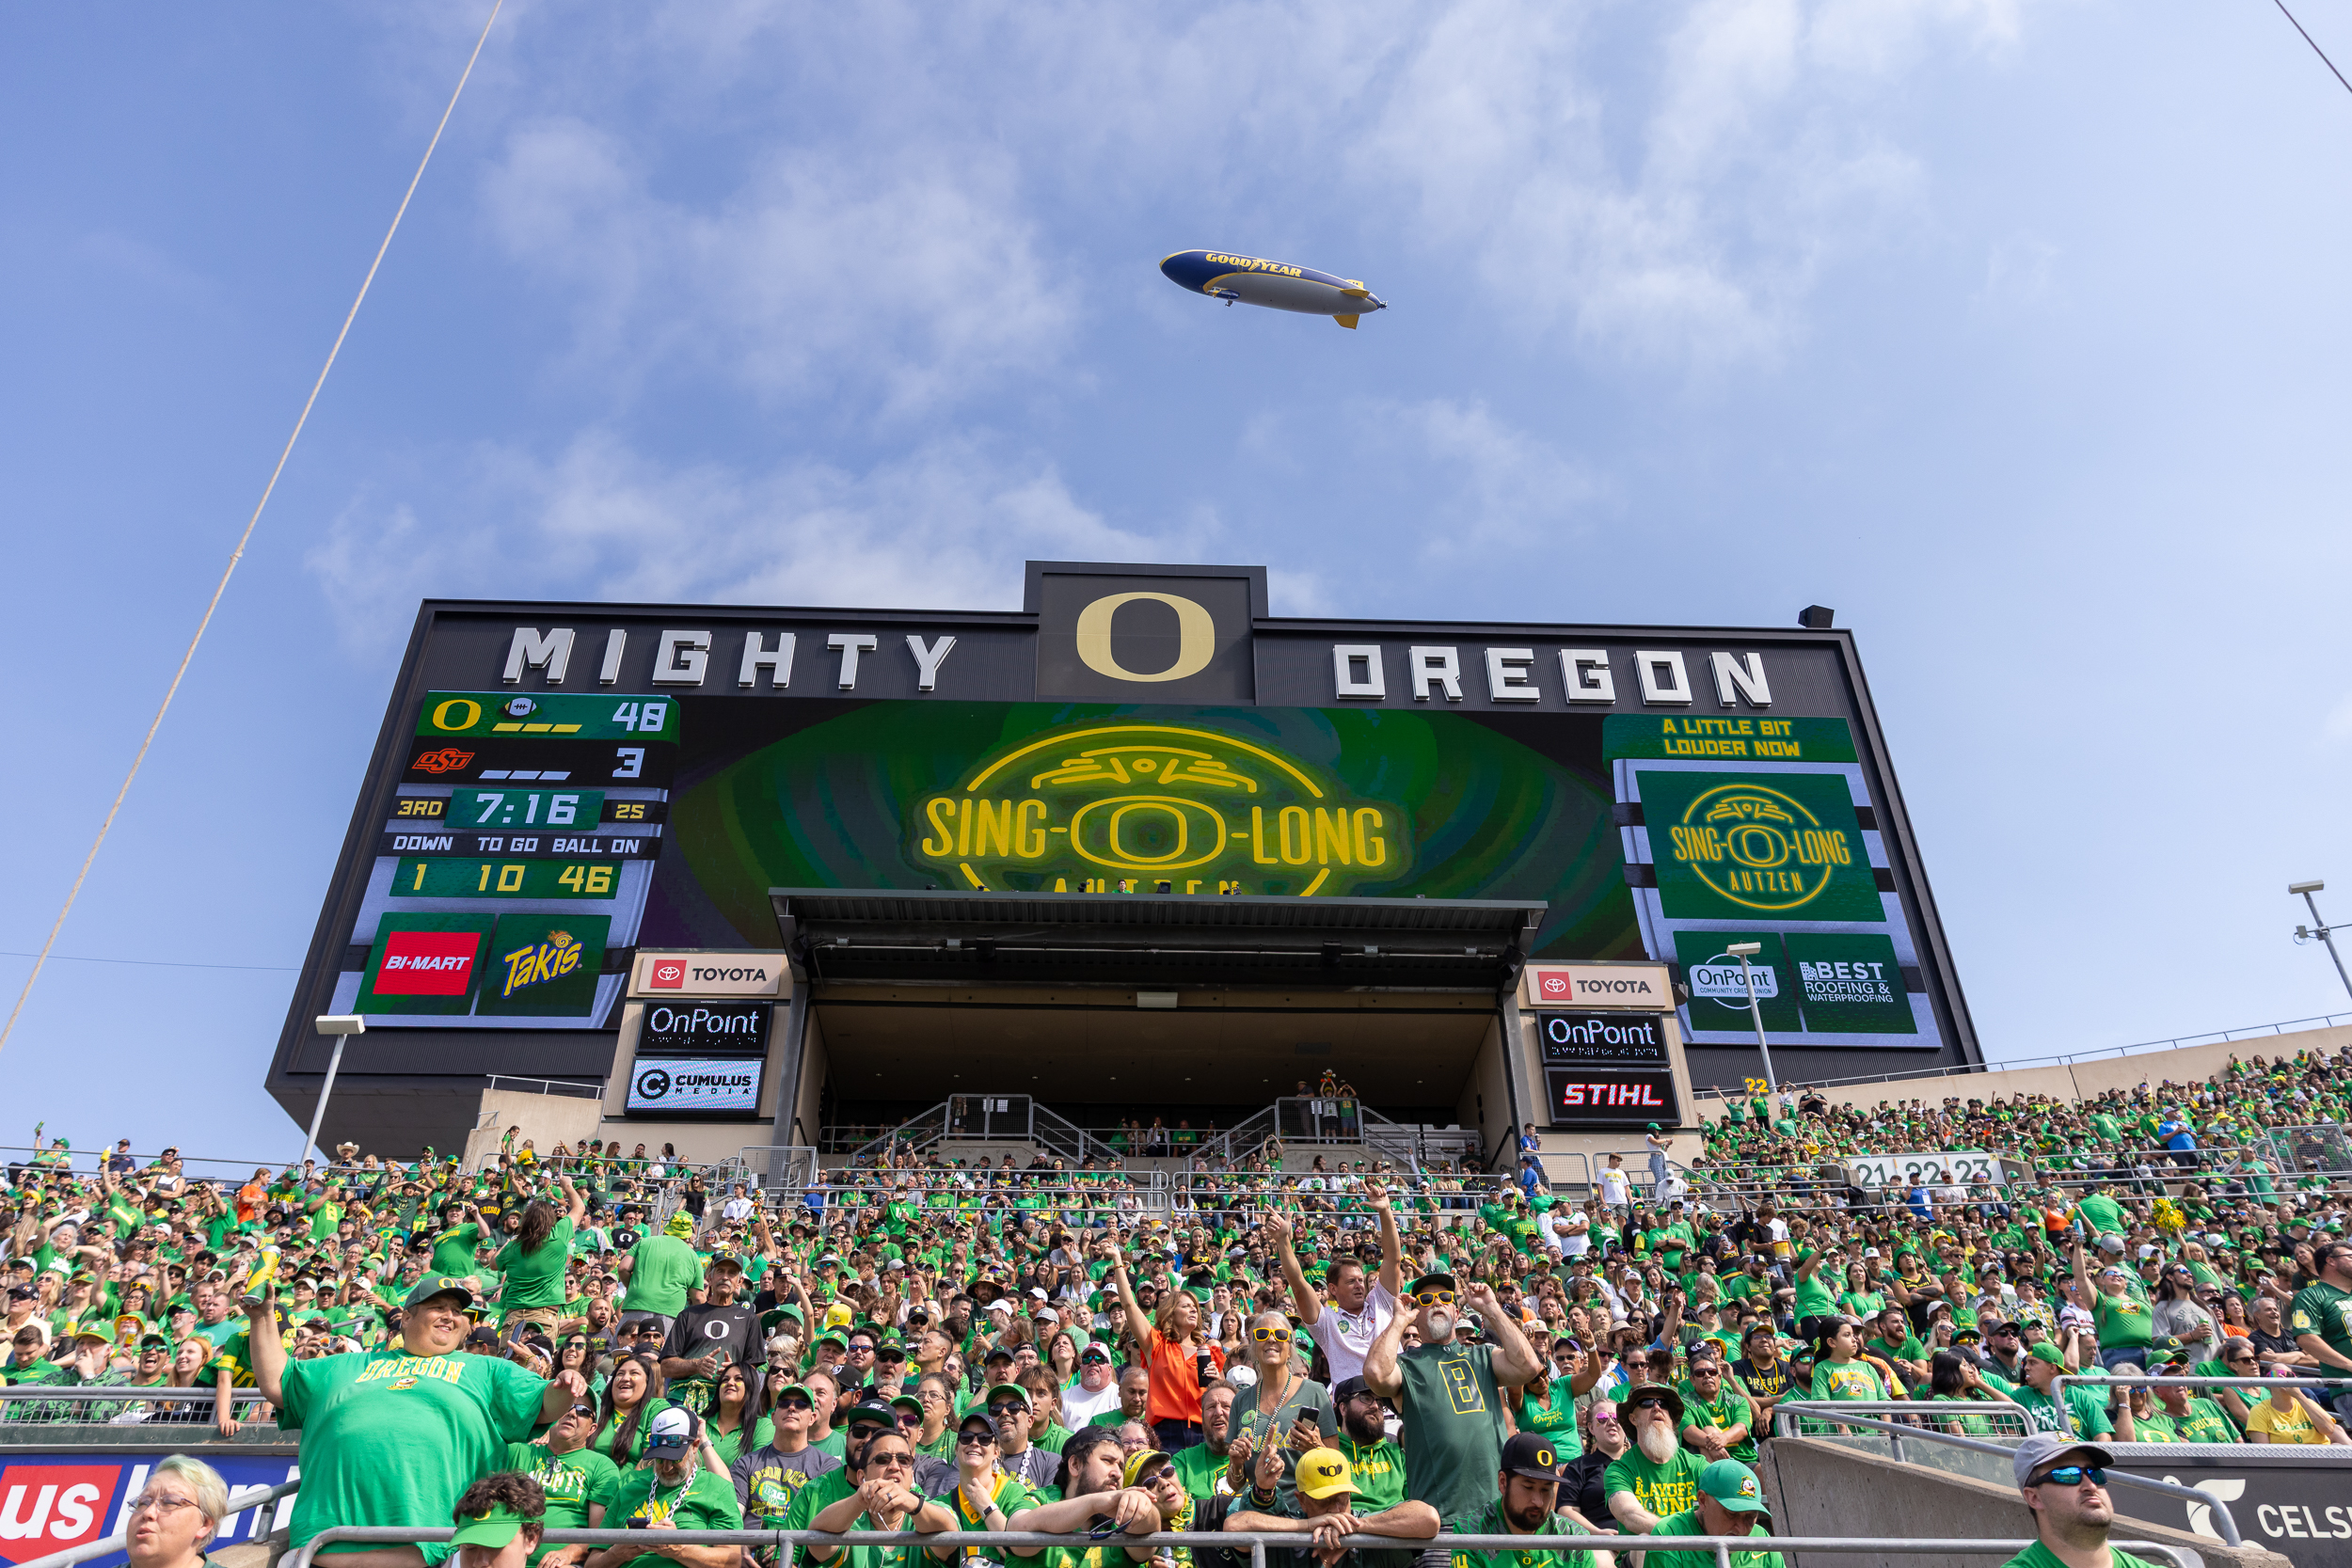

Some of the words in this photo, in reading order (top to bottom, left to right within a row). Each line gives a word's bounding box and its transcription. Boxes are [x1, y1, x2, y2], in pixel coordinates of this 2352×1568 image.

[1205, 253, 1302, 277] GOODYEAR
[1076, 591, 1216, 682] O
[502, 627, 957, 691] MIGHTY
[1333, 644, 1772, 708] OREGON
[612, 702, 667, 732] 48
[1663, 719, 1677, 734] A
[1683, 719, 1754, 736] LITTLE
[1759, 721, 1791, 736] BIT
[1663, 739, 1747, 755] LOUDER
[1754, 741, 1801, 756] NOW
[612, 748, 645, 778] 3
[397, 800, 443, 816] 3RD
[476, 793, 580, 825] 7:16
[392, 835, 453, 851] DOWN
[478, 837, 503, 852] TO
[509, 838, 539, 853] GO
[551, 838, 602, 853] BALL
[611, 839, 640, 853] ON
[412, 863, 428, 891] 1
[478, 864, 525, 893] 10
[558, 865, 612, 893] 46
[1729, 871, 1803, 892] AUTZEN
[385, 956, 470, 971] BI-MART
[1816, 961, 1883, 980] BEST
[691, 966, 767, 982] TOYOTA
[1696, 968, 1770, 987] OnPont
[1577, 979, 1651, 994] TOYOTA
[1804, 981, 1874, 994] ROOFING
[1879, 982, 1891, 995] &
[1807, 993, 1894, 1003] WATERPROOFING
[650, 1007, 759, 1034] OnPoint
[1549, 1018, 1656, 1045] OnPoint
[675, 1074, 752, 1086] CUMULUS
[1744, 1077, 1770, 1093] 22
[1564, 1083, 1663, 1106] STIHL
[1856, 1164, 1891, 1187] 21
[1906, 1162, 1941, 1185] 22
[1955, 1158, 1993, 1182] 23
[479, 1207, 501, 1216] OREGON
[355, 1355, 466, 1384] OREGON
[1438, 1358, 1486, 1415] 8
[1746, 1374, 1787, 1386] OREGON
[1829, 1371, 1876, 1391] DUCKS
[2190, 1417, 2222, 1433] DUCKS
